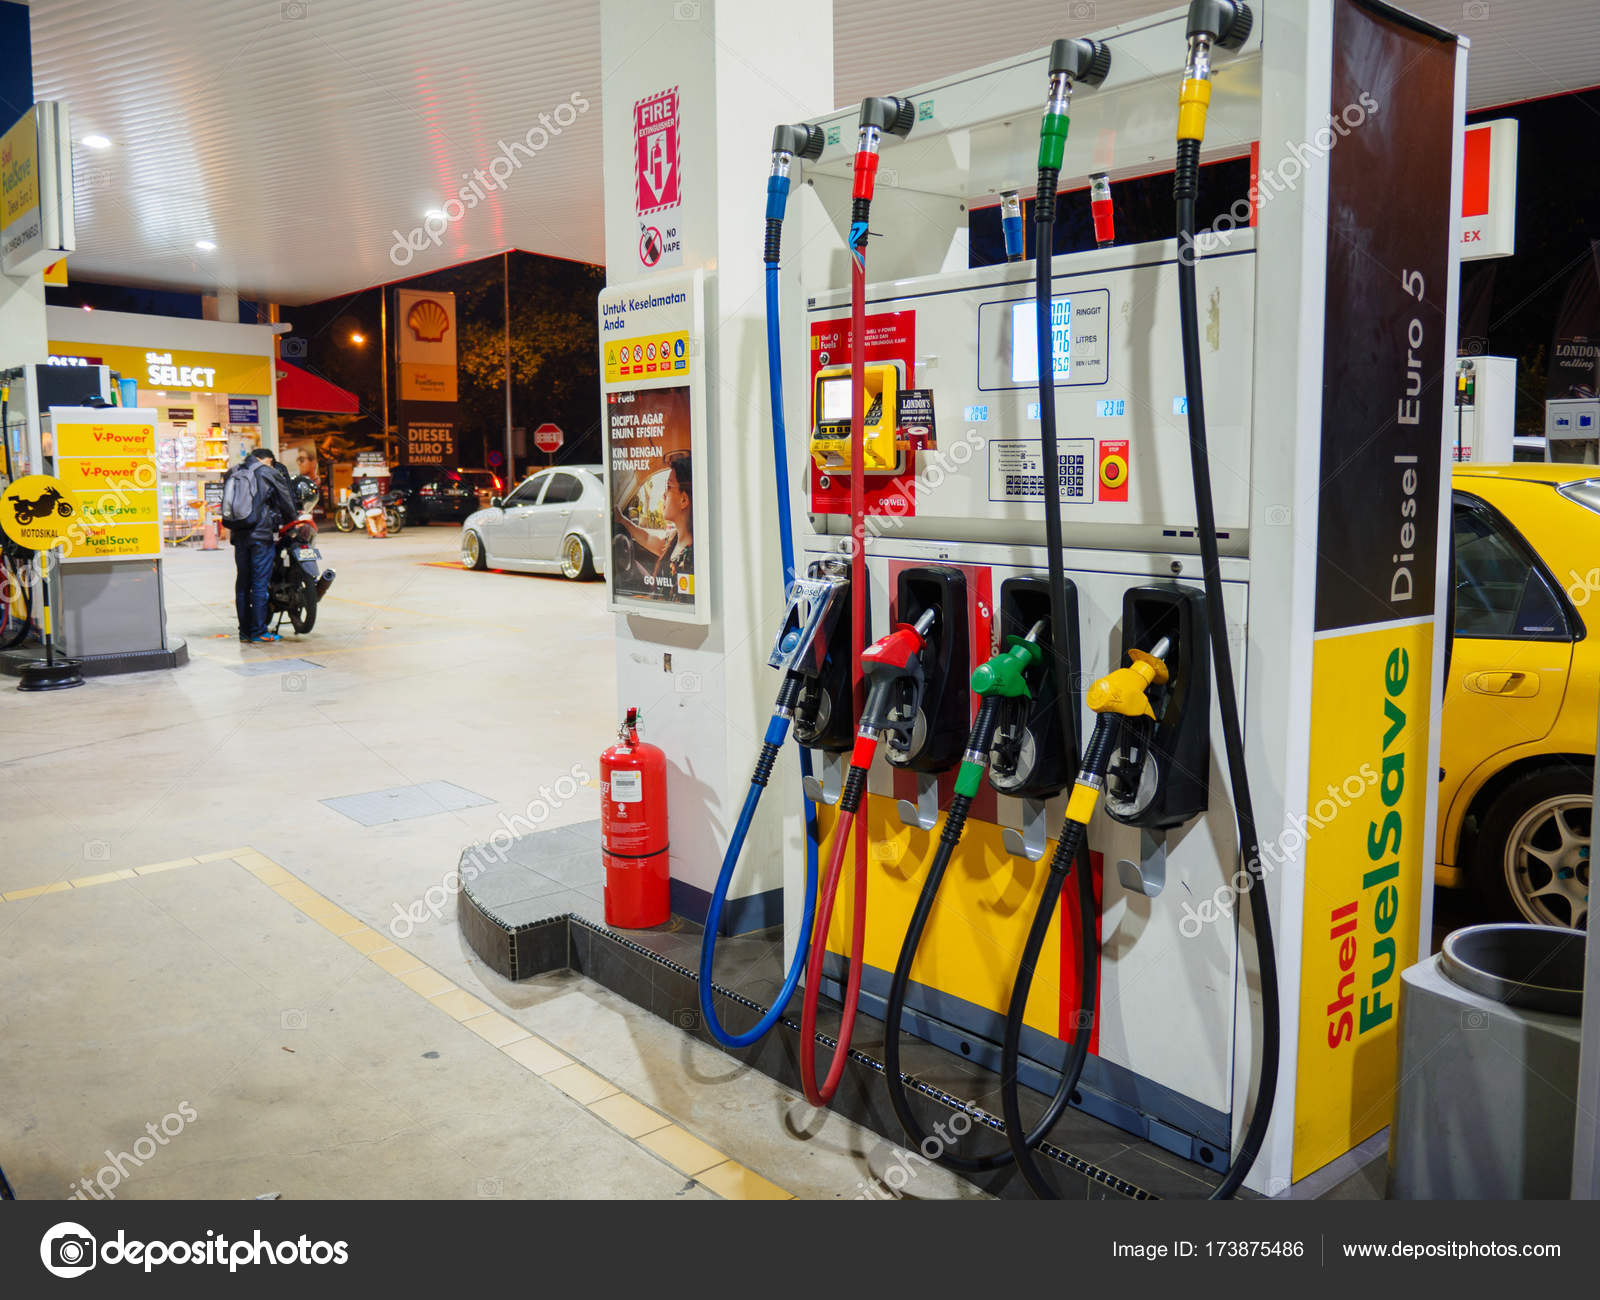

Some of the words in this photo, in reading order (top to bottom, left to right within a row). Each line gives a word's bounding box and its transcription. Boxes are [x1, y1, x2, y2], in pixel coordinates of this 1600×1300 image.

[641, 99, 672, 125] FIRE
[639, 118, 674, 137] EXTINGUISHER
[666, 227, 677, 238] NO
[1460, 230, 1481, 243] EX
[663, 240, 681, 253] VAPE
[1402, 268, 1425, 302] 5
[602, 300, 627, 317] Untuk
[629, 291, 687, 312] Keselamatan
[1076, 306, 1101, 316] RINGGIT
[604, 318, 626, 332] Anda
[1076, 335, 1097, 344] LITRES
[1556, 345, 1600, 357] LONDON
[148, 365, 216, 388] SELECT
[1397, 318, 1423, 425] Euro
[902, 400, 931, 409] LONDON'S
[611, 415, 640, 427] DICIPTA
[641, 412, 664, 425] AGAR
[93, 432, 147, 443] V-Power
[408, 429, 453, 442] DIESEL
[612, 428, 634, 440] ENJIN
[408, 443, 442, 455] EURO
[445, 443, 454, 455] 5
[612, 447, 628, 459] KINI
[630, 446, 663, 458] DENGAN
[408, 455, 442, 465] BAHARU
[612, 459, 650, 471] DYNAFLEX
[81, 467, 134, 478] V-Power
[879, 498, 890, 506] GO
[890, 498, 906, 506] WELL
[83, 504, 138, 516] FuelSave
[21, 528, 60, 539] MOTOSIKAL
[1390, 455, 1418, 602] Diesel
[86, 536, 139, 546] FuelSave
[644, 576, 655, 585] GO
[656, 576, 673, 587] WELL
[1359, 647, 1409, 1035] FuelSave
[1327, 900, 1359, 1049] Shell
